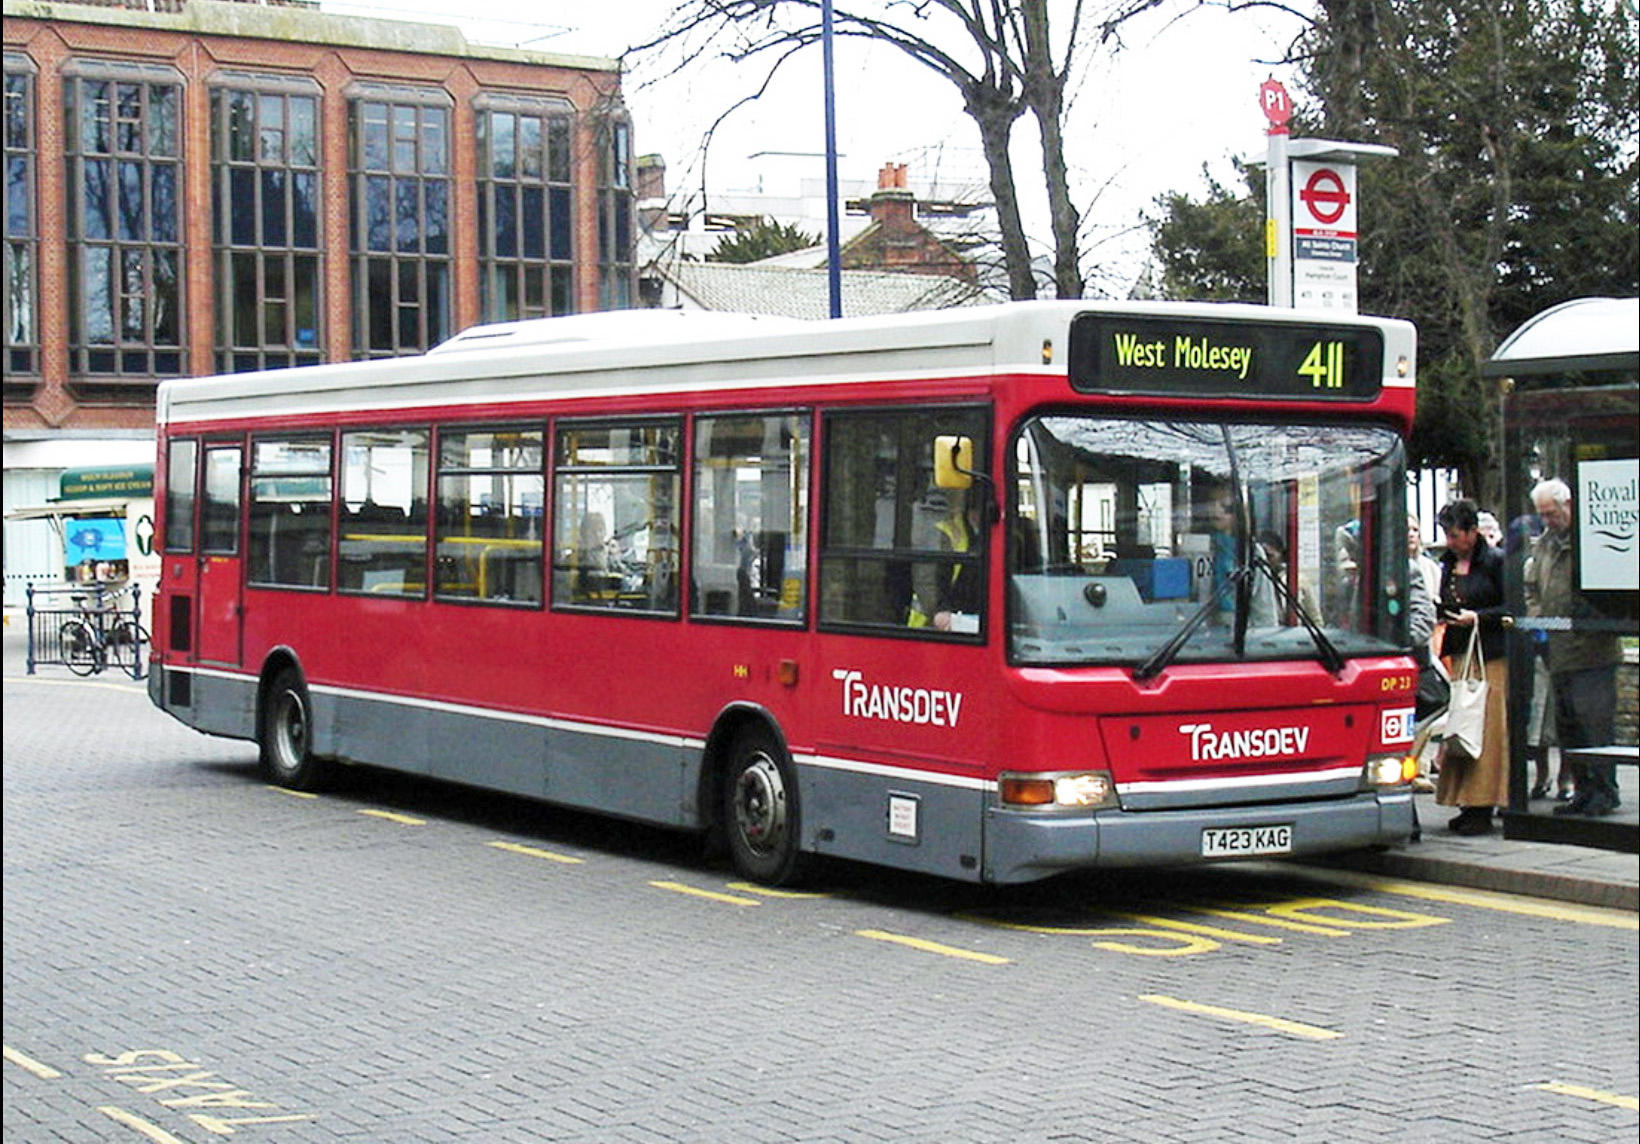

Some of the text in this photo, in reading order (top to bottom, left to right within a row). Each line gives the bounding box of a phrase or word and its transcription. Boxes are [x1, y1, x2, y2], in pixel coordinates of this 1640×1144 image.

[1264, 88, 1286, 112] P1
[1115, 333, 1343, 388] West Molesey 411
[1588, 478, 1636, 502] Royal
[1381, 677, 1397, 691] DP
[832, 669, 962, 728] TRANSDEV
[1179, 723, 1310, 761] TRANSDEV
[1207, 828, 1290, 851] T423 KAG
